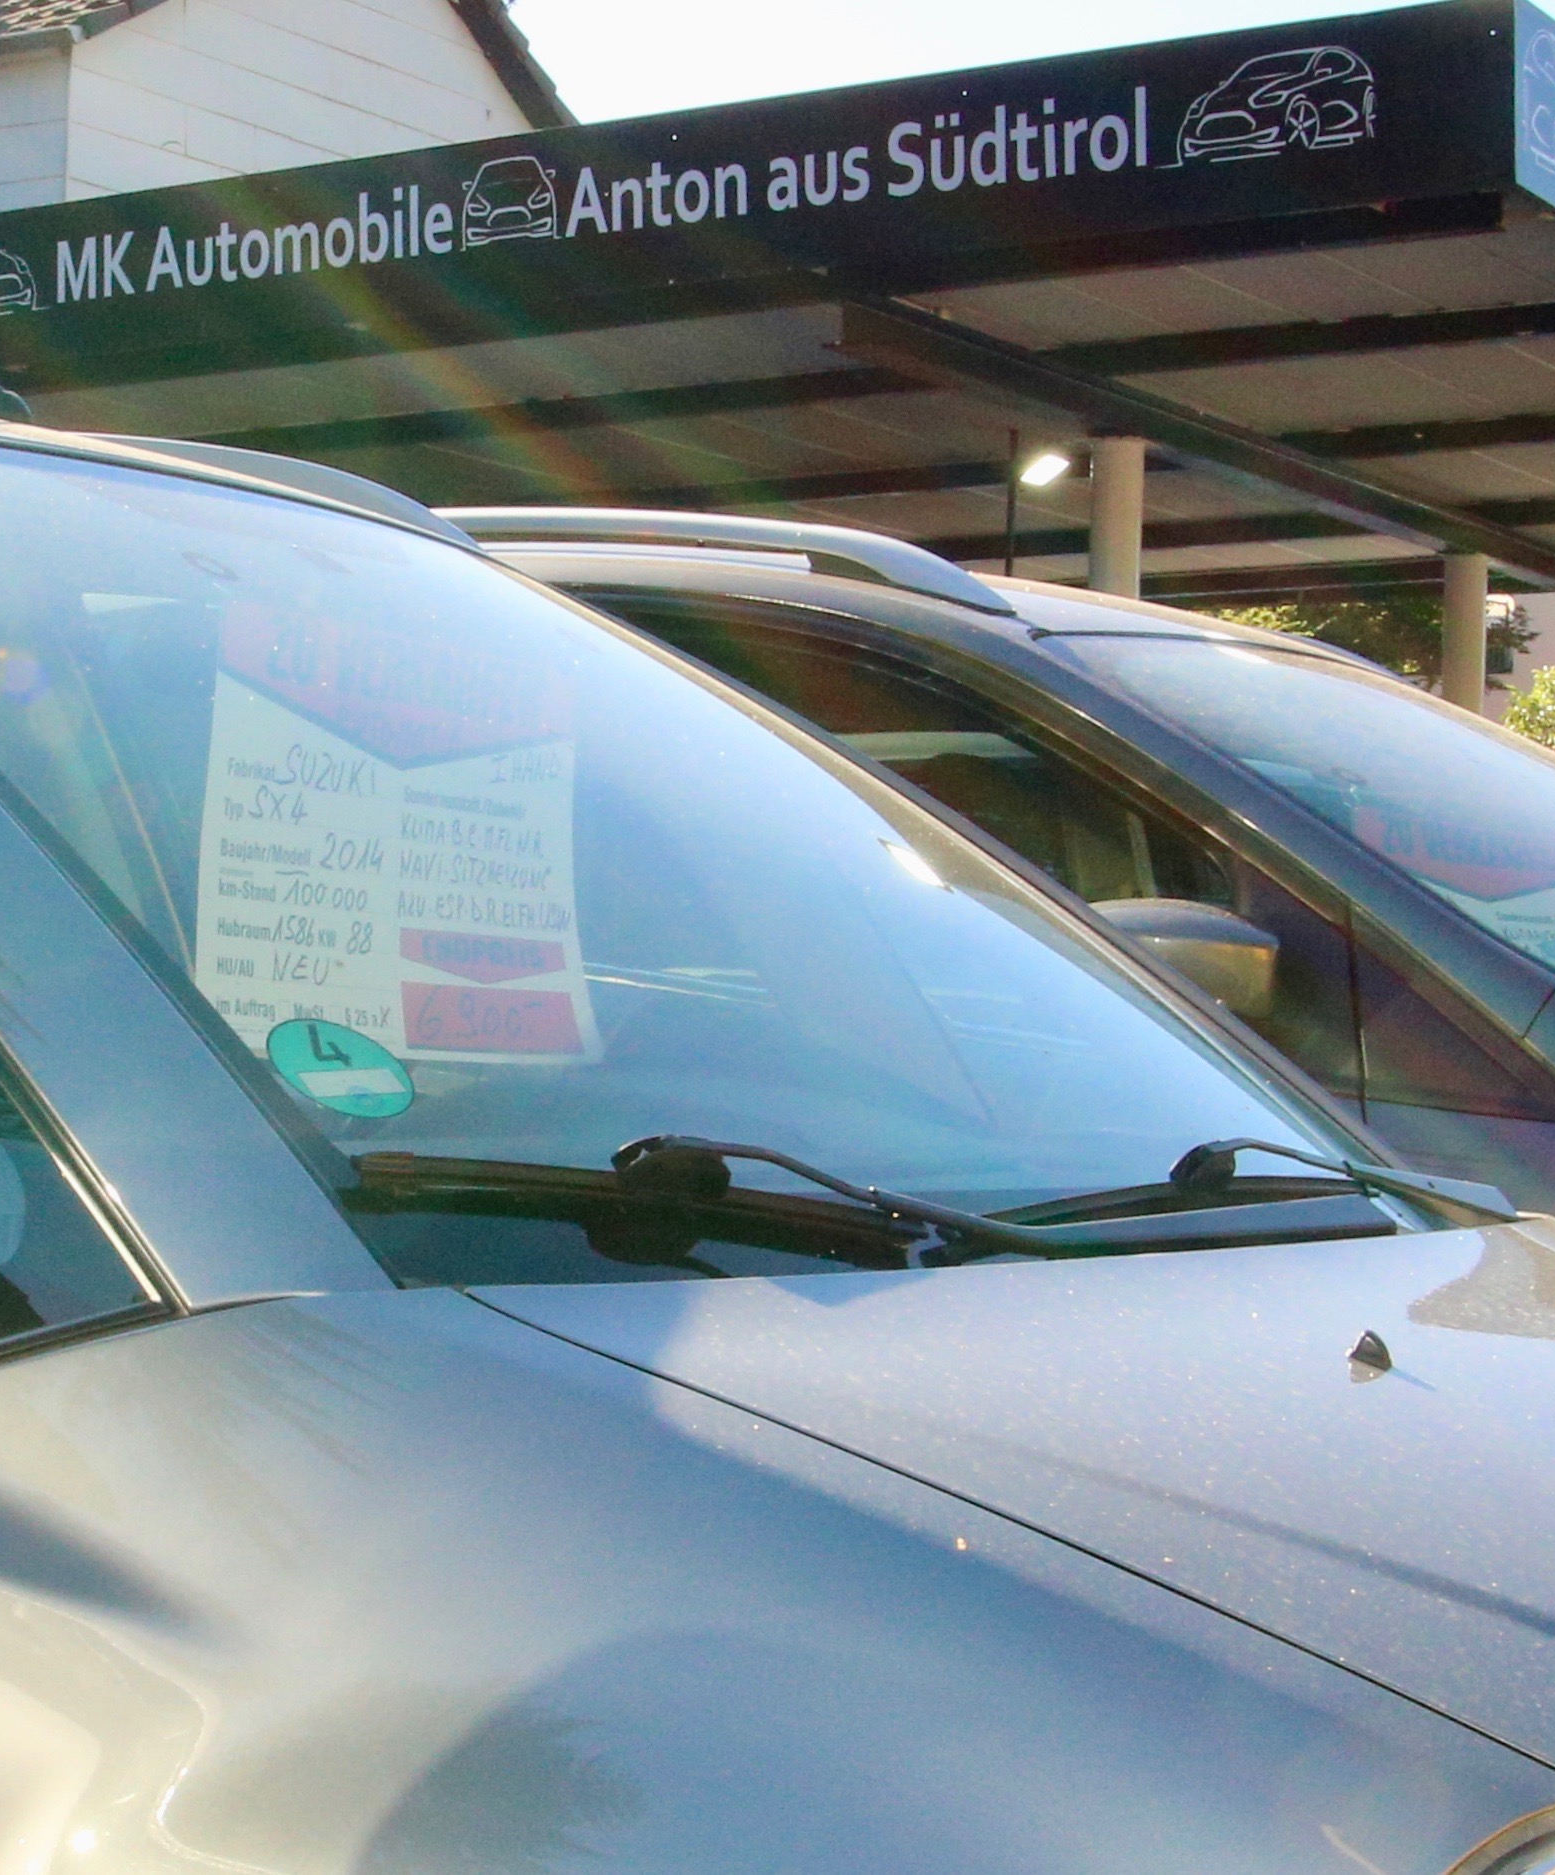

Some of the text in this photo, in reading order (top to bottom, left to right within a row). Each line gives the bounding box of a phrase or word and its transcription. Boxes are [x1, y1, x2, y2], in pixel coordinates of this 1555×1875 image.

[55, 86, 1148, 304] MK Automobile Anton aus Südtirol
[229, 744, 376, 797] Fabrikat SUZUKI
[224, 797, 245, 821] Typ
[220, 831, 384, 874] Baujahr/Modell 2014
[218, 877, 276, 900] km-Stand
[217, 917, 272, 941] Hubraum
[346, 921, 373, 955] 88
[217, 956, 255, 978] HU/AU
[235, 998, 275, 1022] Auftrag
[307, 1022, 351, 1068] 4
